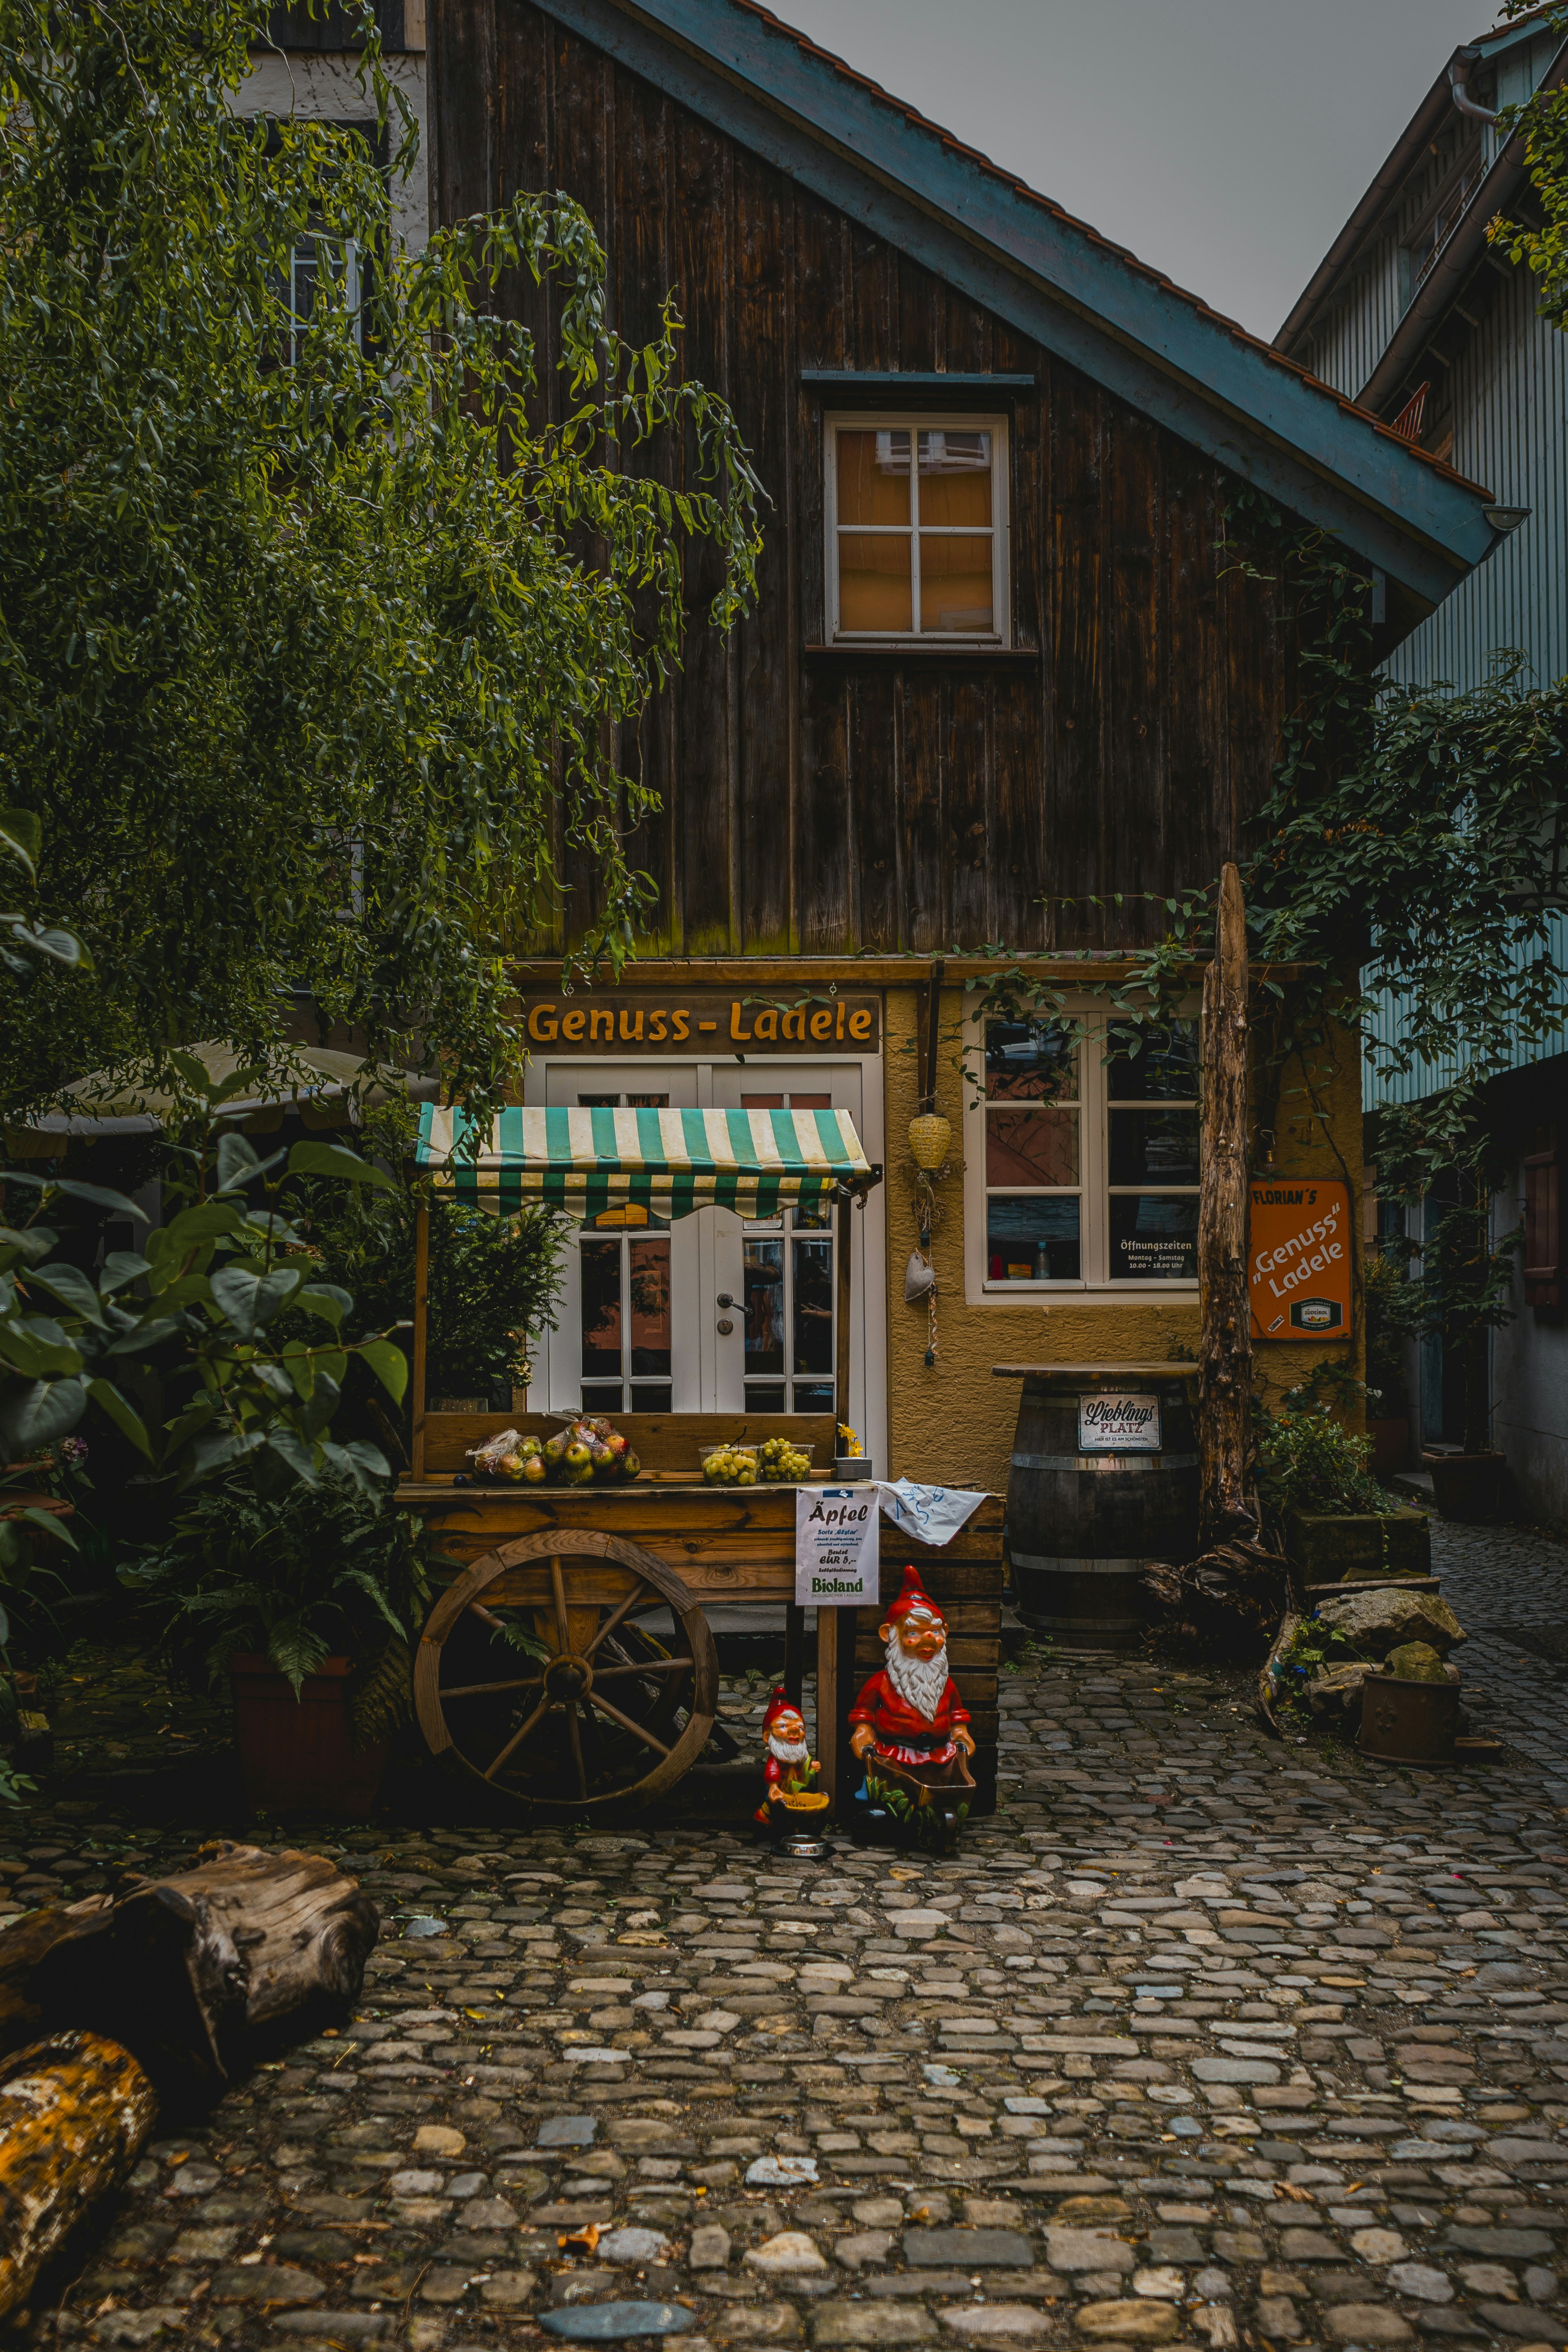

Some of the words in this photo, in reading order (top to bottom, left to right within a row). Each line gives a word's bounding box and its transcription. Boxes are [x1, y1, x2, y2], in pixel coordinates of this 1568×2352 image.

[528, 1004, 690, 1041] Genuss
[730, 1002, 871, 1040] Ladele
[1120, 1239, 1192, 1251] Öffnungszeiten
[1269, 1242, 1343, 1298] Ladele
[1085, 1400, 1155, 1426] Lieblings
[1100, 1422, 1143, 1433] PLATZ
[808, 1500, 868, 1526] Äpfel
[819, 1556, 840, 1564] EUR
[811, 1577, 863, 1593] Bioland
